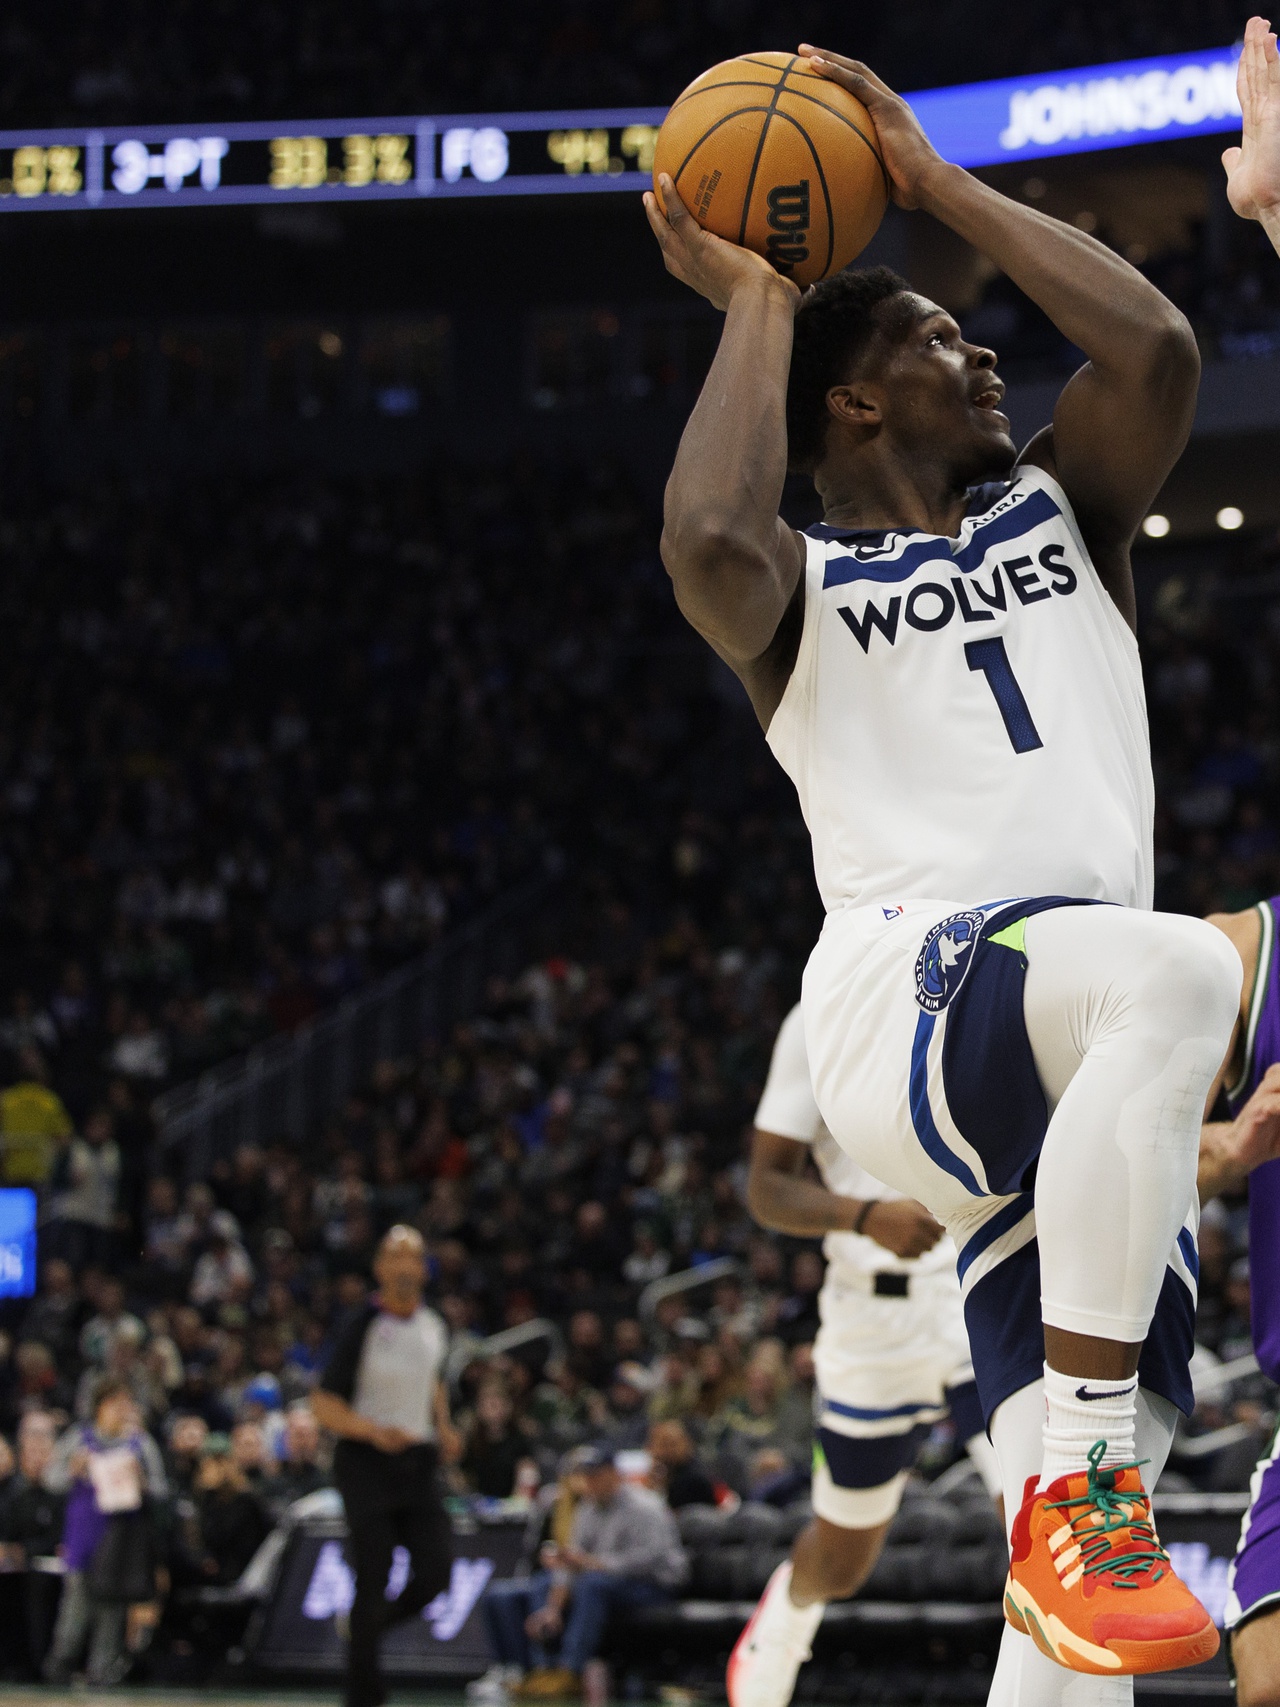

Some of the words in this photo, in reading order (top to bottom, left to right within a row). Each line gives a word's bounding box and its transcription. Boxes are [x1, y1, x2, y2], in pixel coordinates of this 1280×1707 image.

[111, 138, 229, 194] 3-PT
[442, 126, 509, 182] FG
[836, 543, 1078, 654] WOLVES
[963, 635, 1044, 754] 1
